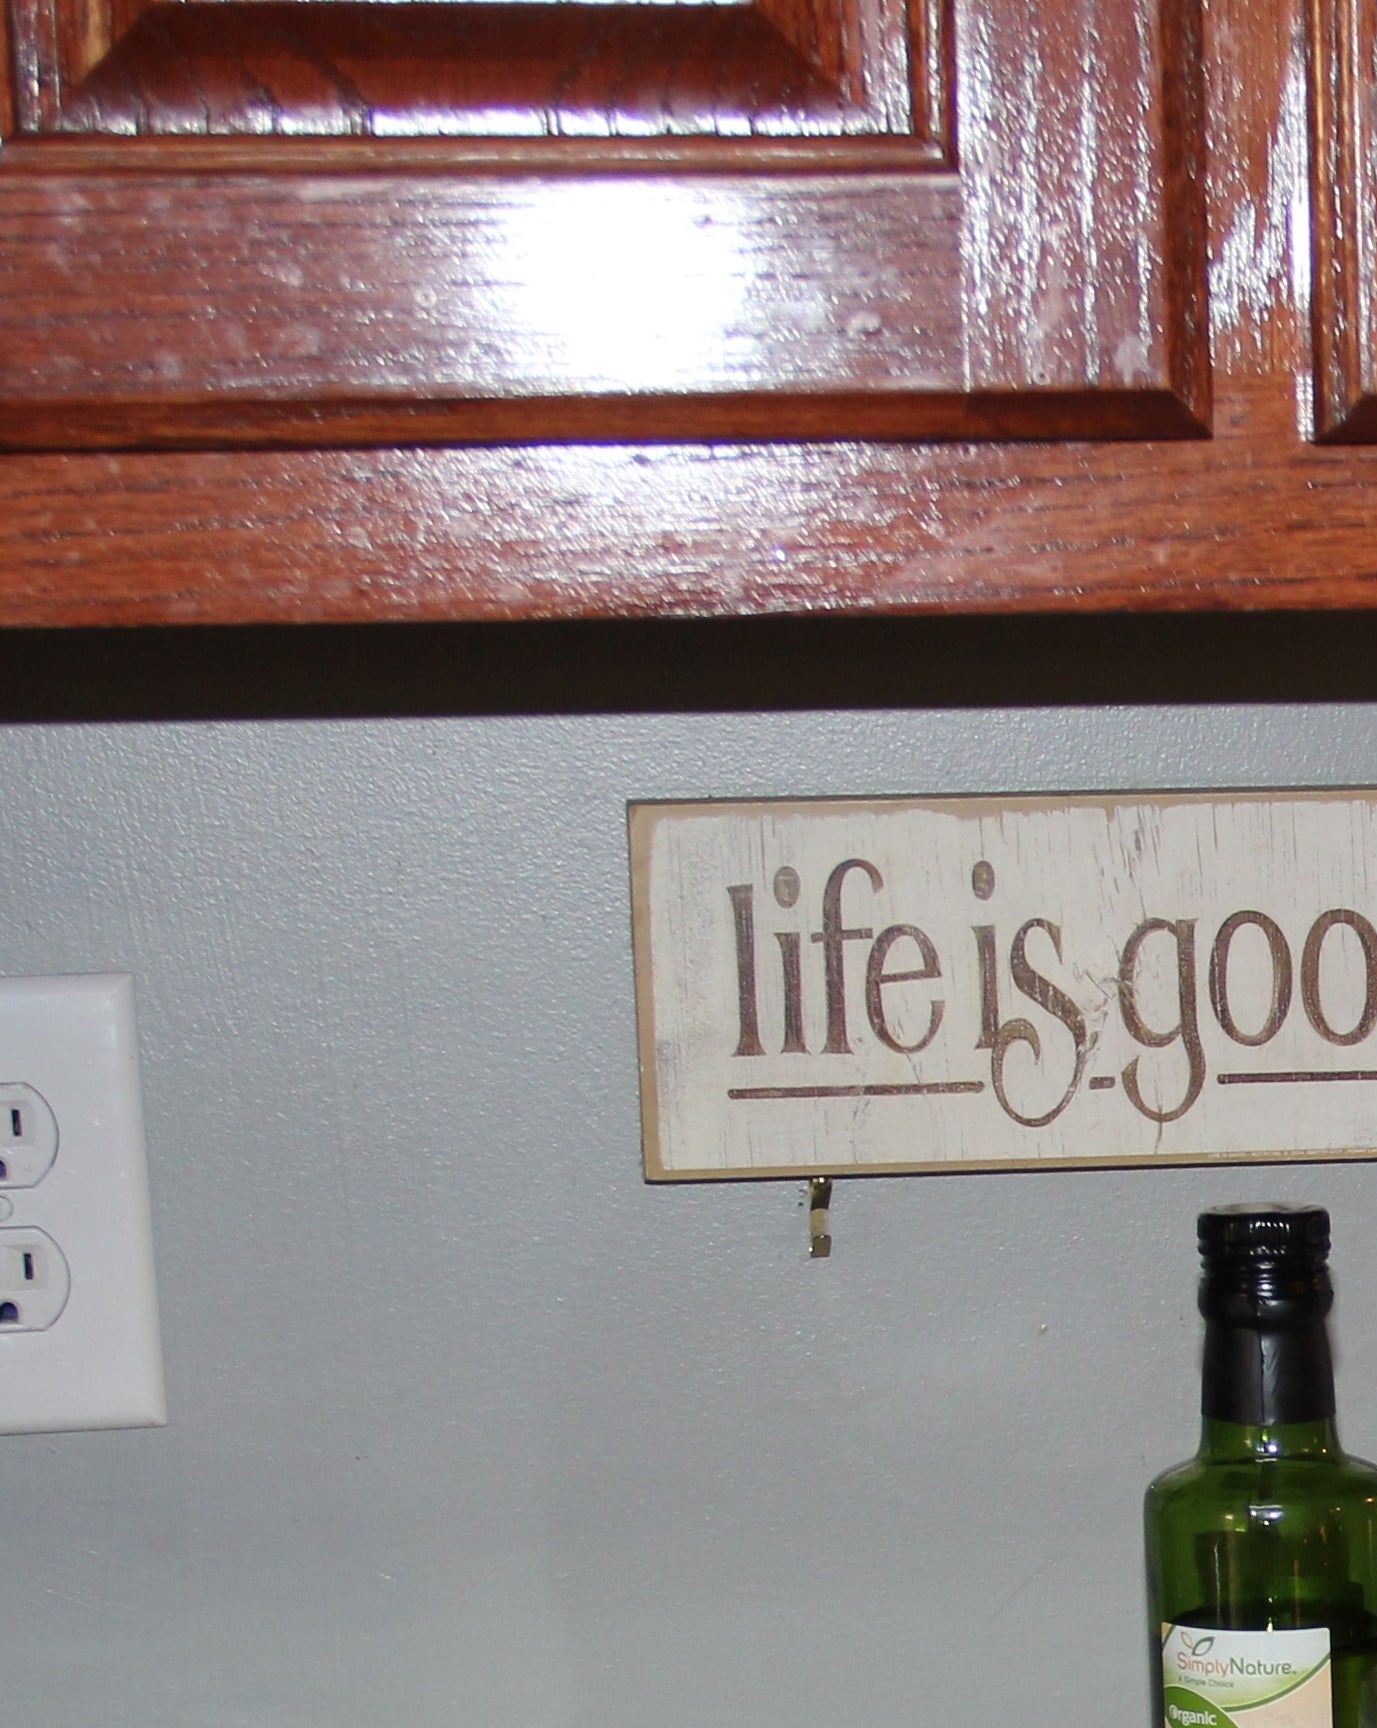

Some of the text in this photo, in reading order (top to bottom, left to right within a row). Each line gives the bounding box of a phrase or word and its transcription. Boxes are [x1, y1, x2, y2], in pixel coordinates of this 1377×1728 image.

[727, 859, 945, 1056] life
[971, 860, 1087, 1128] is
[1169, 1704, 1217, 1727] Organic
